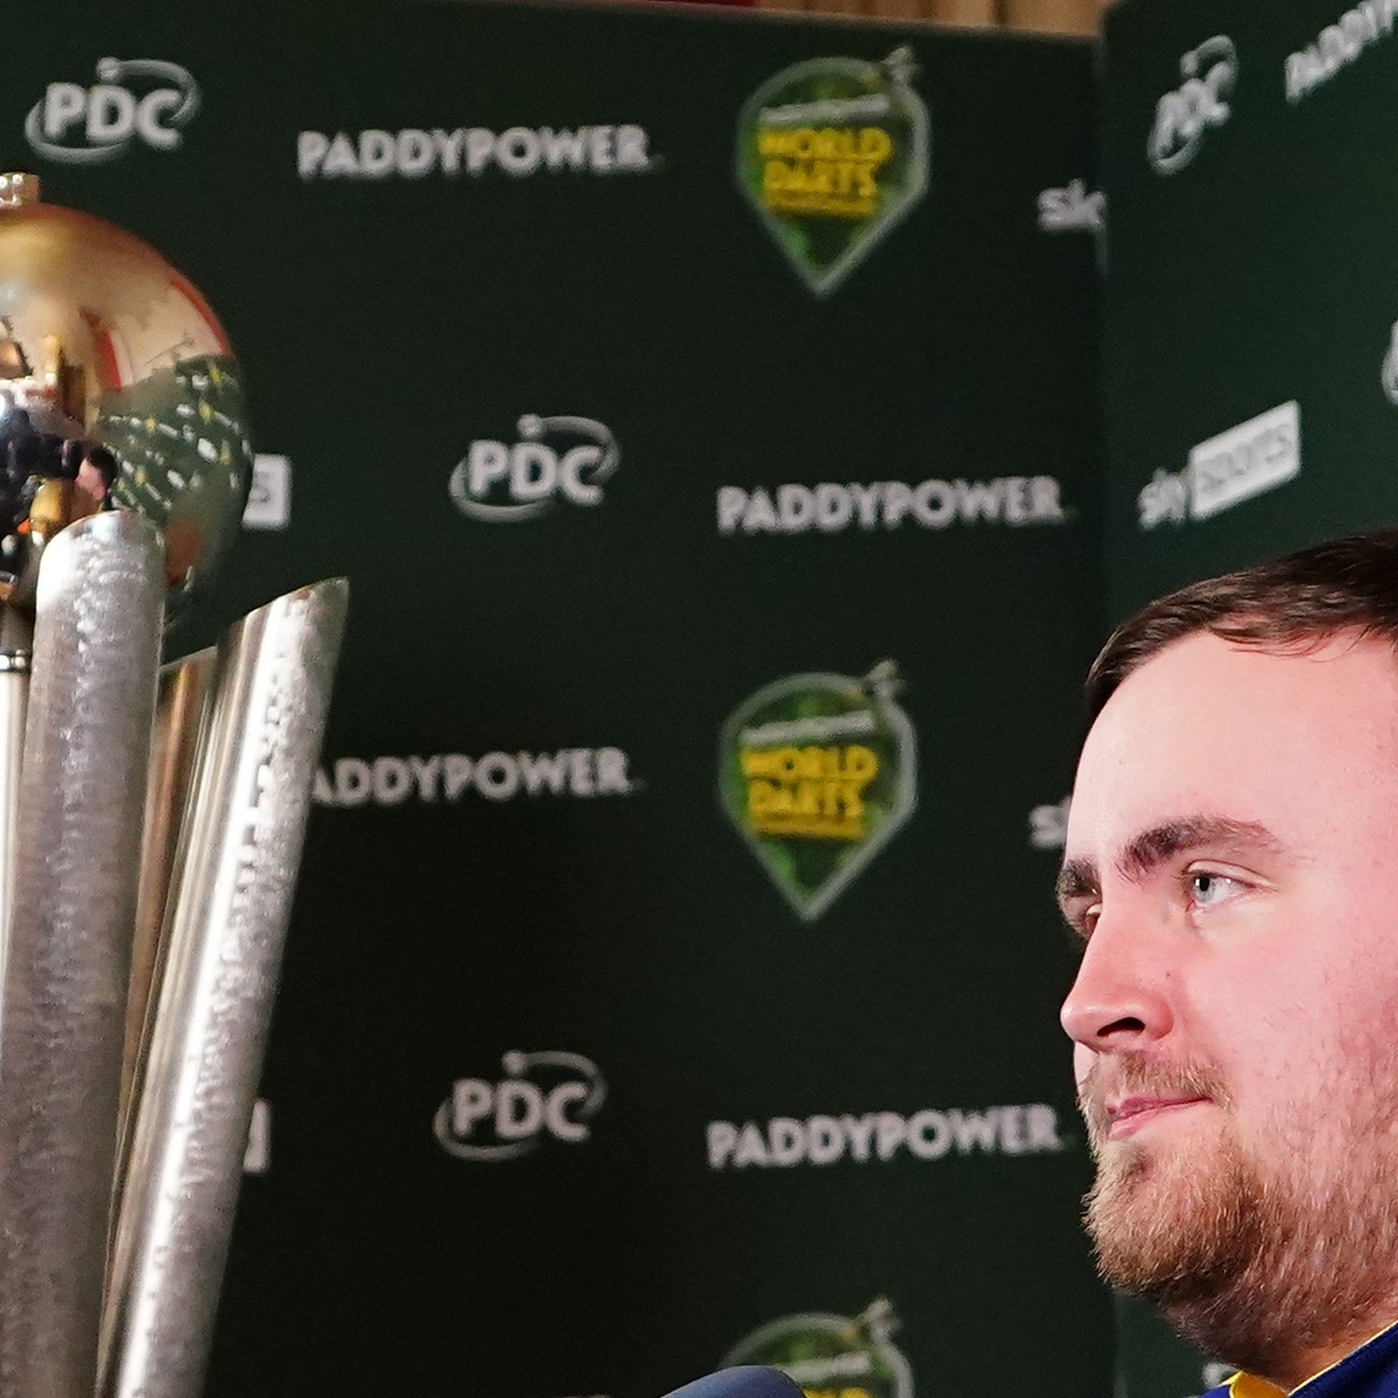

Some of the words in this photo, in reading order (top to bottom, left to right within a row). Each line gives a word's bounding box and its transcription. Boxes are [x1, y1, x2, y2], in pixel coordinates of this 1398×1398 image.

[46, 83, 186, 150] PDC
[757, 127, 893, 161] WORLD
[467, 441, 603, 506] PDC
[741, 745, 880, 783] WORLD
[452, 1079, 591, 1145] PDC
